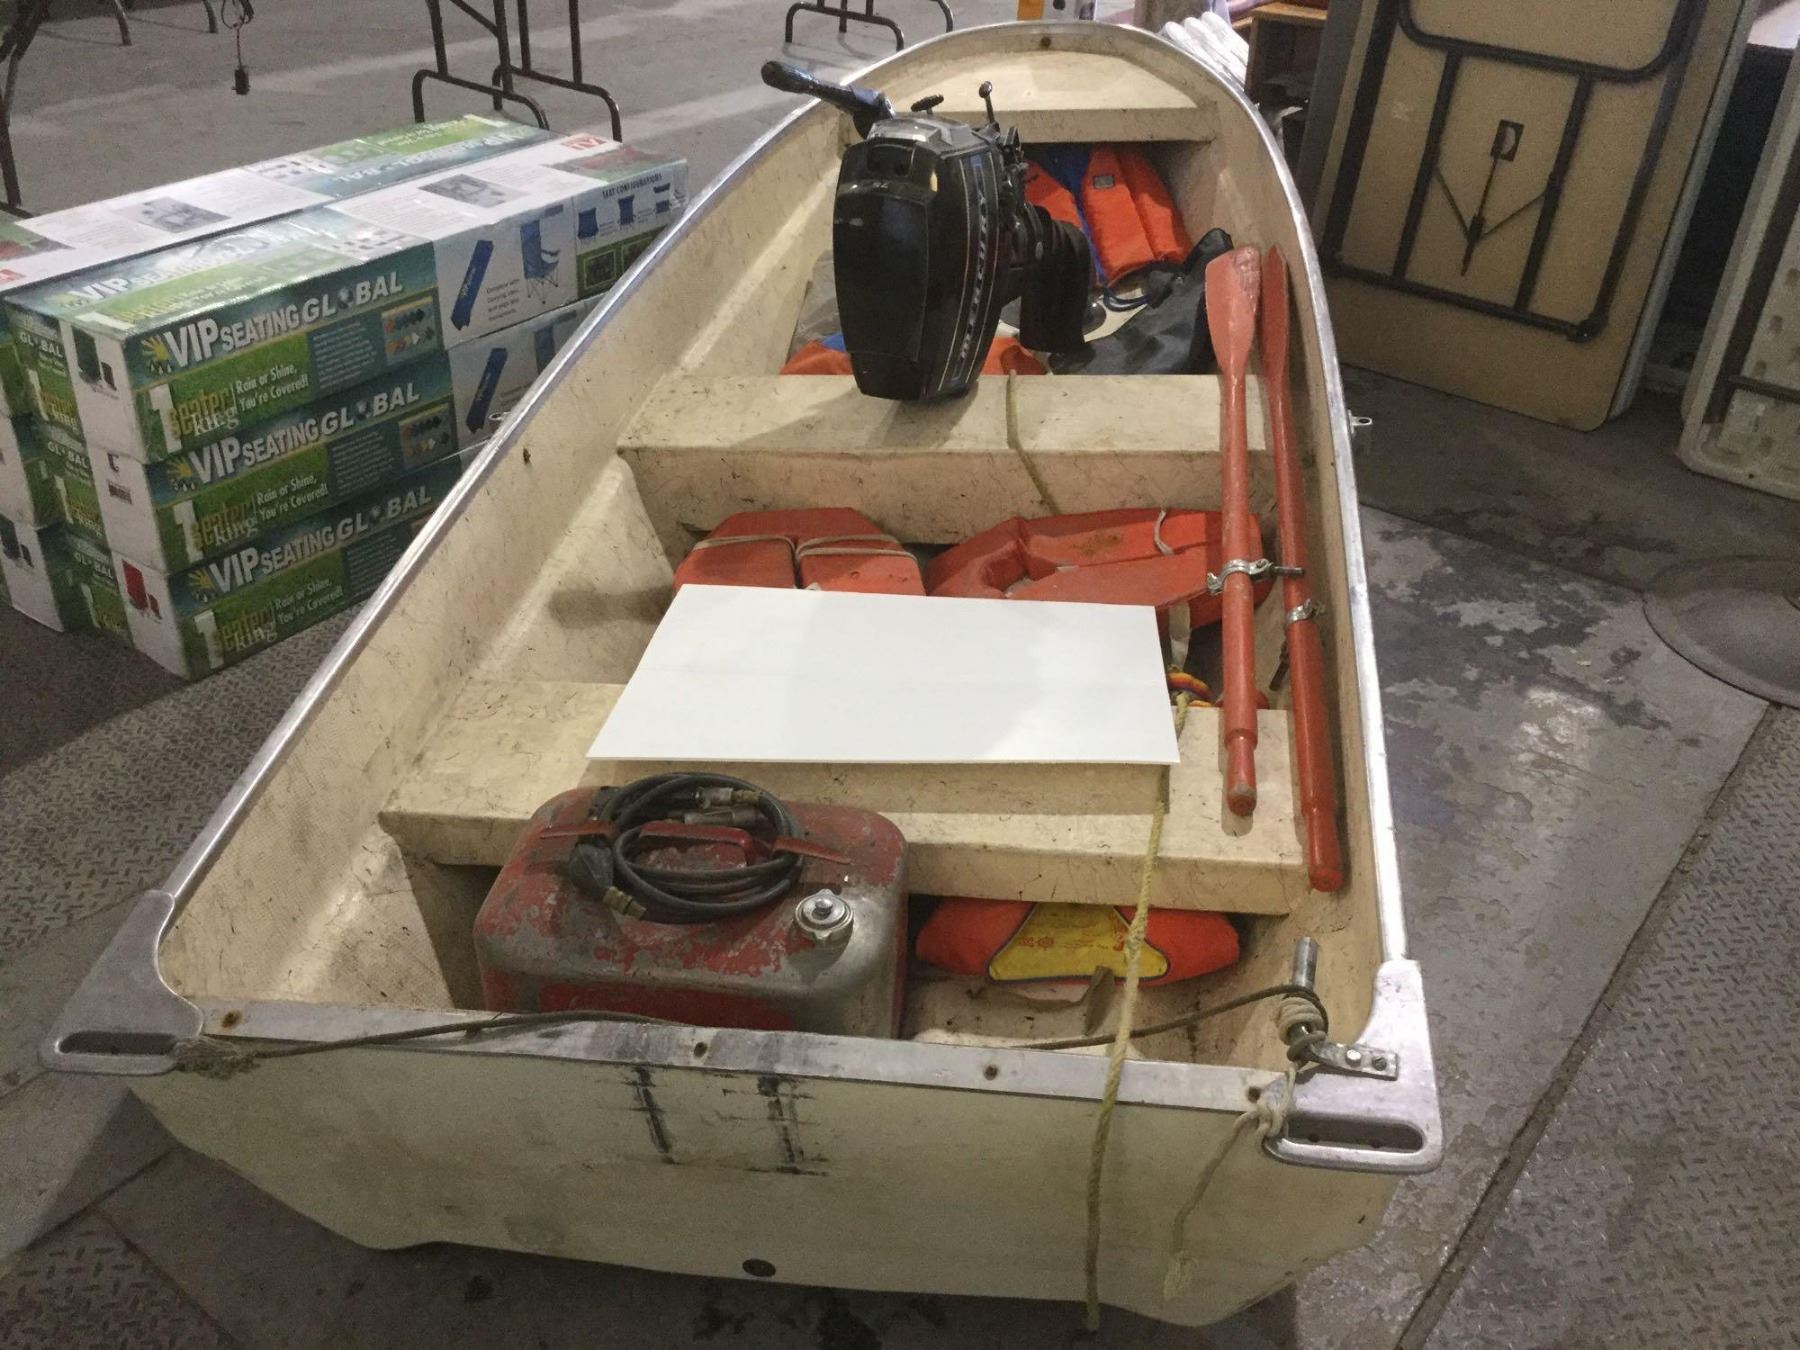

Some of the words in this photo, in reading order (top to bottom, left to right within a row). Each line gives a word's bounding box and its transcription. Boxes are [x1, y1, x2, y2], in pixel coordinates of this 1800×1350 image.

[68, 278, 129, 300] VIP
[164, 318, 219, 367] VIP
[219, 304, 299, 350] SEATING
[235, 379, 258, 394] Rain
[259, 376, 268, 385] or
[269, 364, 298, 381] Shine,
[239, 392, 268, 411] You're
[270, 373, 309, 399] Covered!
[189, 437, 242, 484] VIP
[242, 418, 318, 467] SEATING
[256, 491, 278, 506] Rain
[279, 486, 289, 496] or
[259, 503, 289, 521] You're
[290, 482, 329, 509] Covered!
[209, 547, 259, 594] VIP
[260, 526, 336, 575] SEATING
[275, 595, 296, 610] Rain
